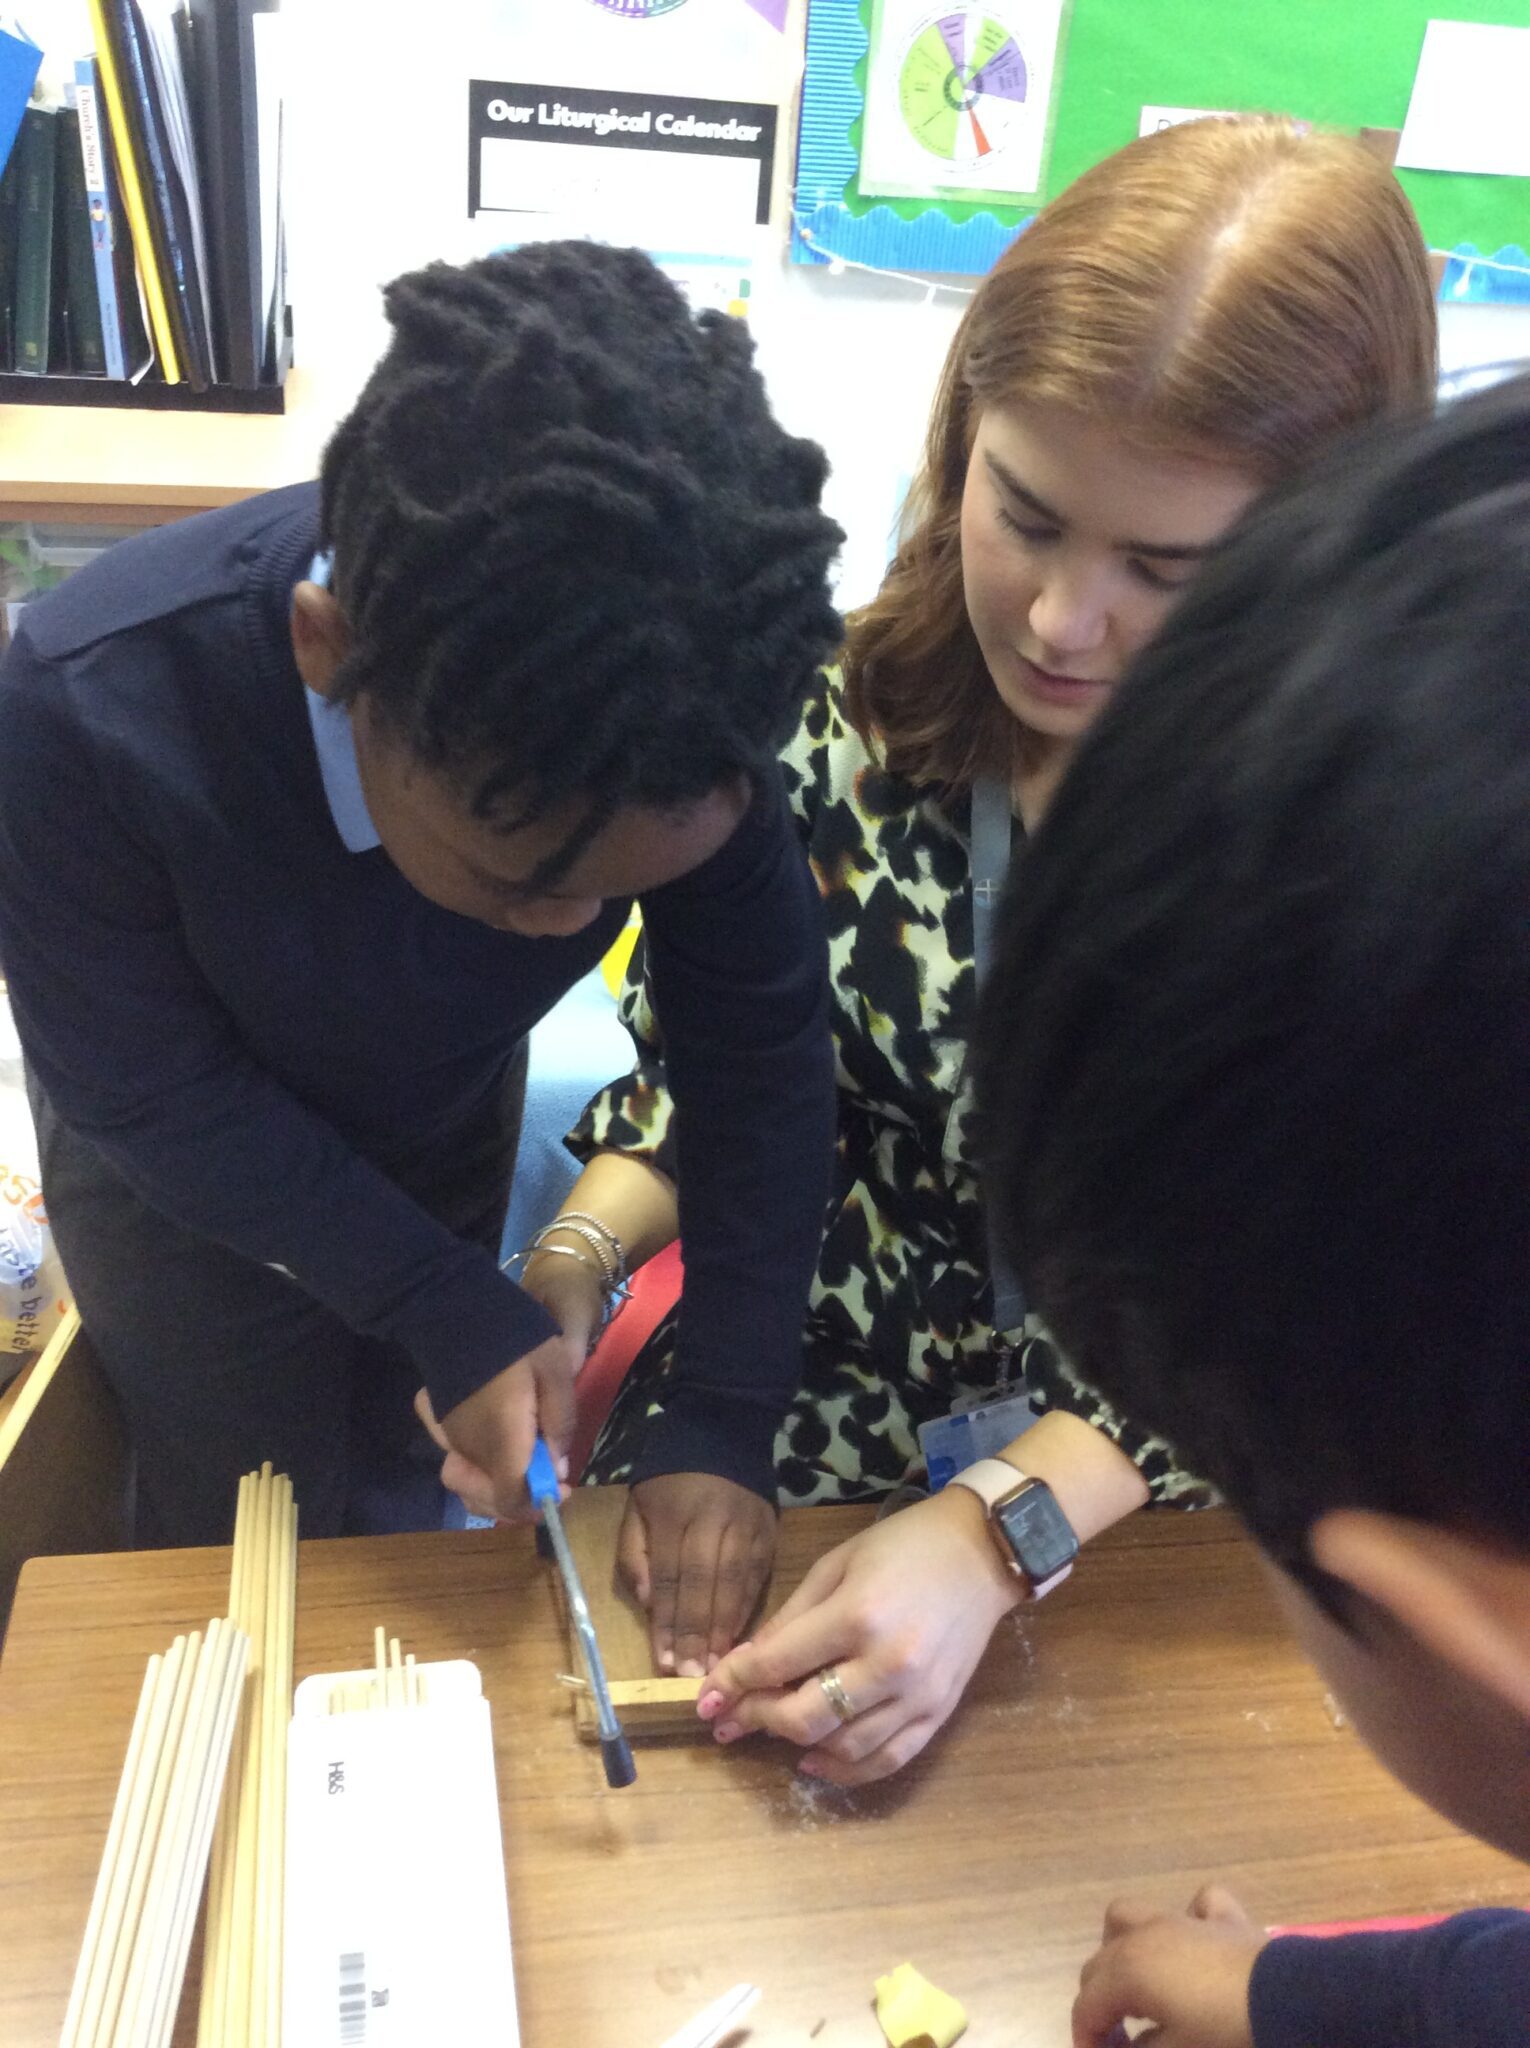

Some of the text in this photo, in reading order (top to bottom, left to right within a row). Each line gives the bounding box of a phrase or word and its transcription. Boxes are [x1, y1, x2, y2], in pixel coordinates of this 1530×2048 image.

[80, 89, 94, 140] Church's
[487, 99, 762, 142] Our Liturgical Calendar
[86, 145, 97, 173] Story
[328, 1761, 344, 1795] H&S
